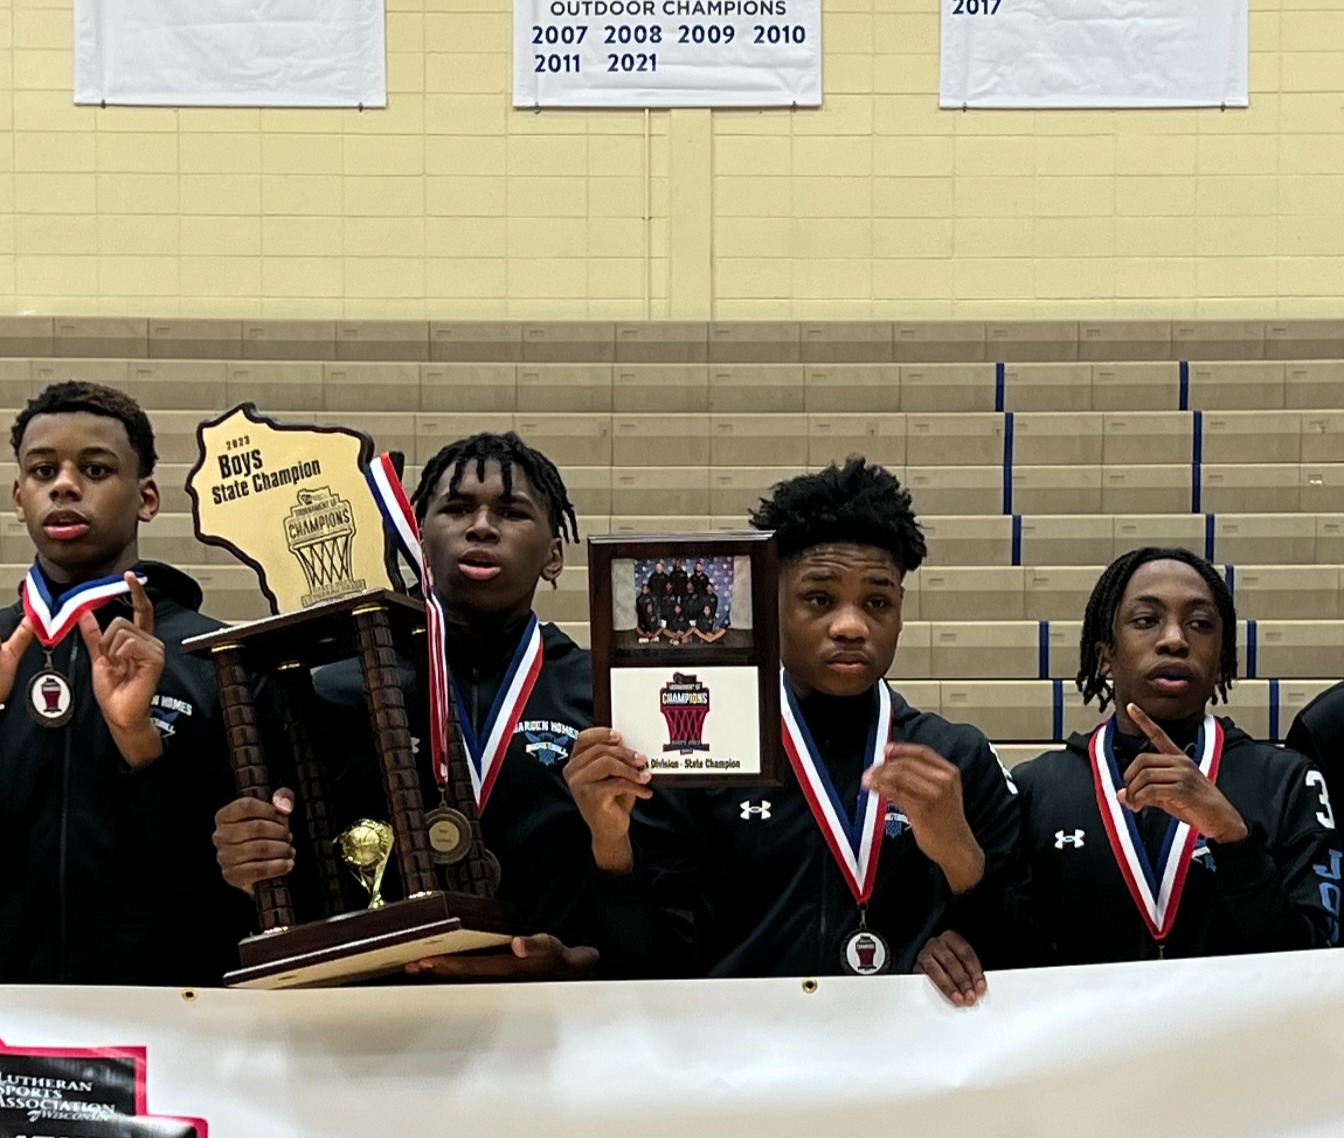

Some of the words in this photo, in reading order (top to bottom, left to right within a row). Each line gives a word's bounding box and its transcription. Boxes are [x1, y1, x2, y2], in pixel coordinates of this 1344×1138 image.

[550, 0, 655, 16] OUTDOOR
[662, 0, 787, 16] CHAMPIONS
[952, 0, 1002, 15] 2017
[532, 25, 588, 44] 2007
[604, 25, 663, 44] 2008
[677, 25, 735, 44] 2009
[753, 25, 806, 44] 2010
[534, 54, 581, 73] 2011
[607, 53, 657, 72] 2021
[218, 448, 263, 479] Boys
[212, 480, 250, 505] State
[252, 459, 321, 493] Champion
[288, 508, 351, 539] CHAMPIONS
[662, 691, 708, 705] CHAMPIONS
[705, 757, 741, 770] Champion
[1305, 770, 1336, 829] 3
